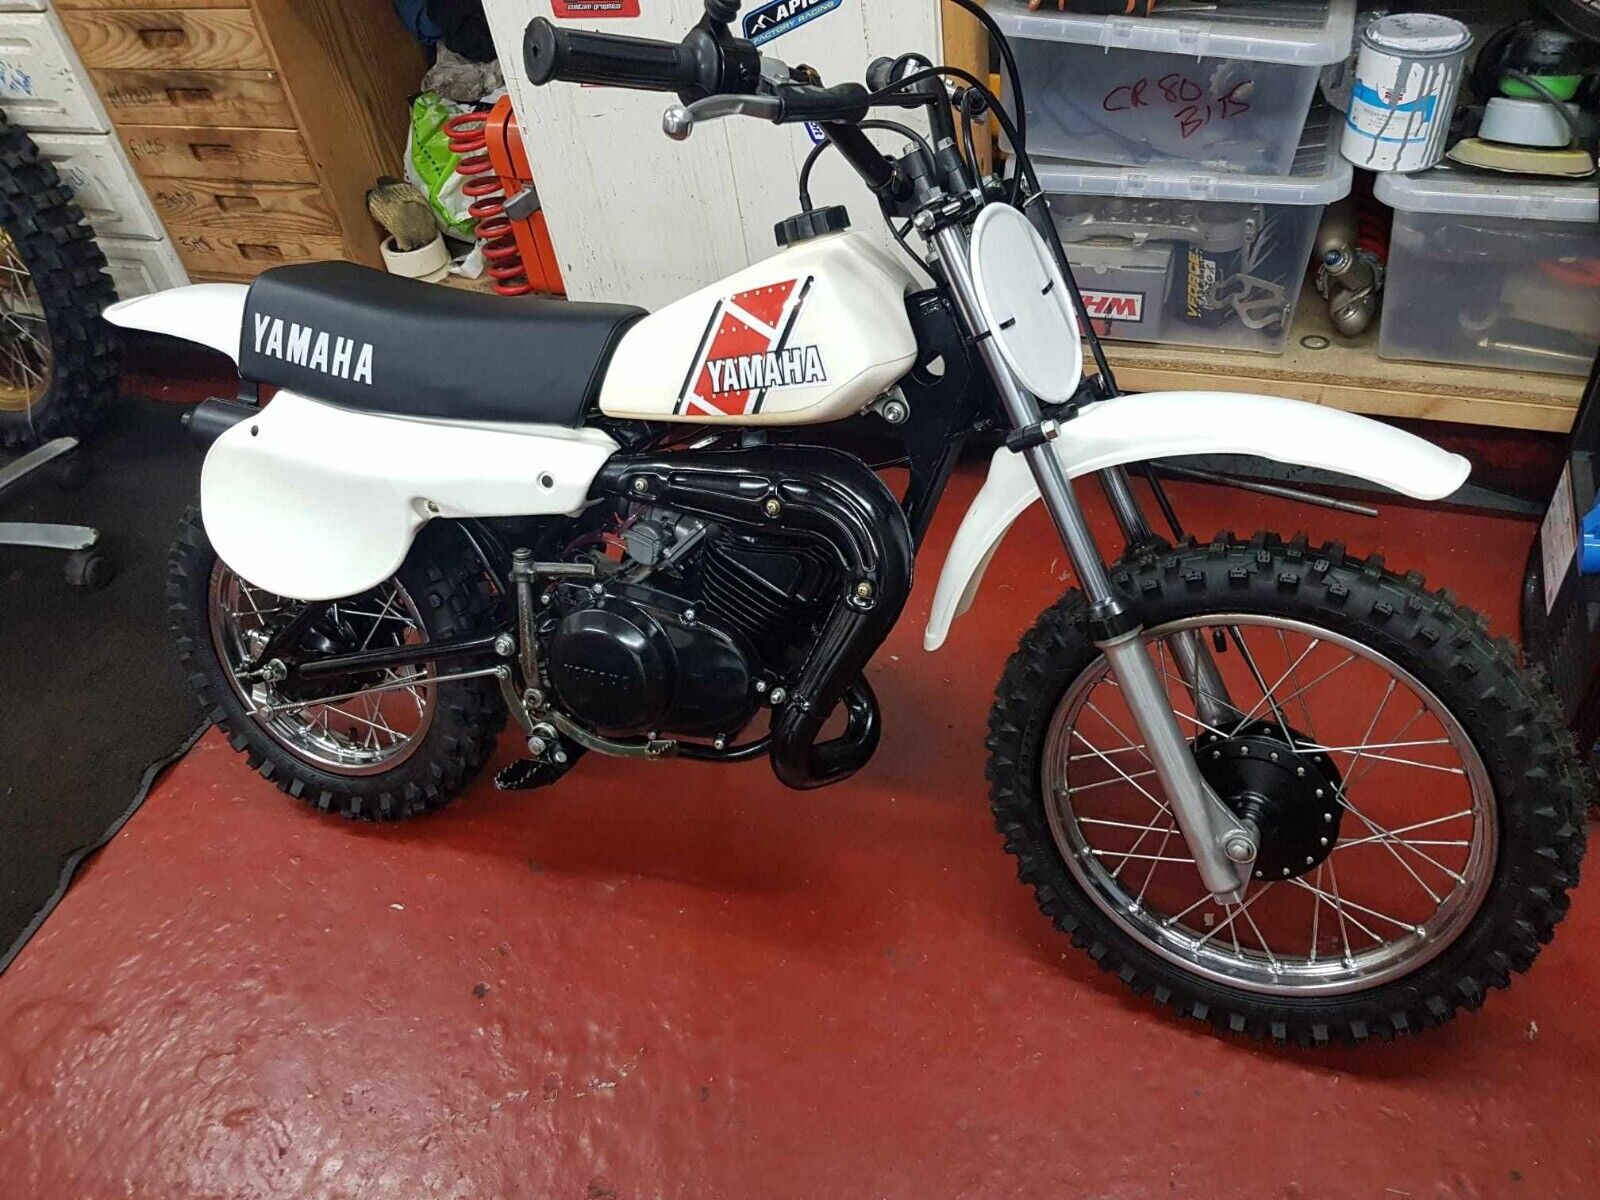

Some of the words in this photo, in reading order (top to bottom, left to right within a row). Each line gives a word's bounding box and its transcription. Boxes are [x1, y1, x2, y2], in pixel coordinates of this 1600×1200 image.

[1103, 78, 1148, 112] CR
[1158, 73, 1202, 102] 80
[1174, 81, 1254, 138] BITS
[255, 312, 373, 385] YAMAHA
[705, 345, 827, 394] YAMAHA
